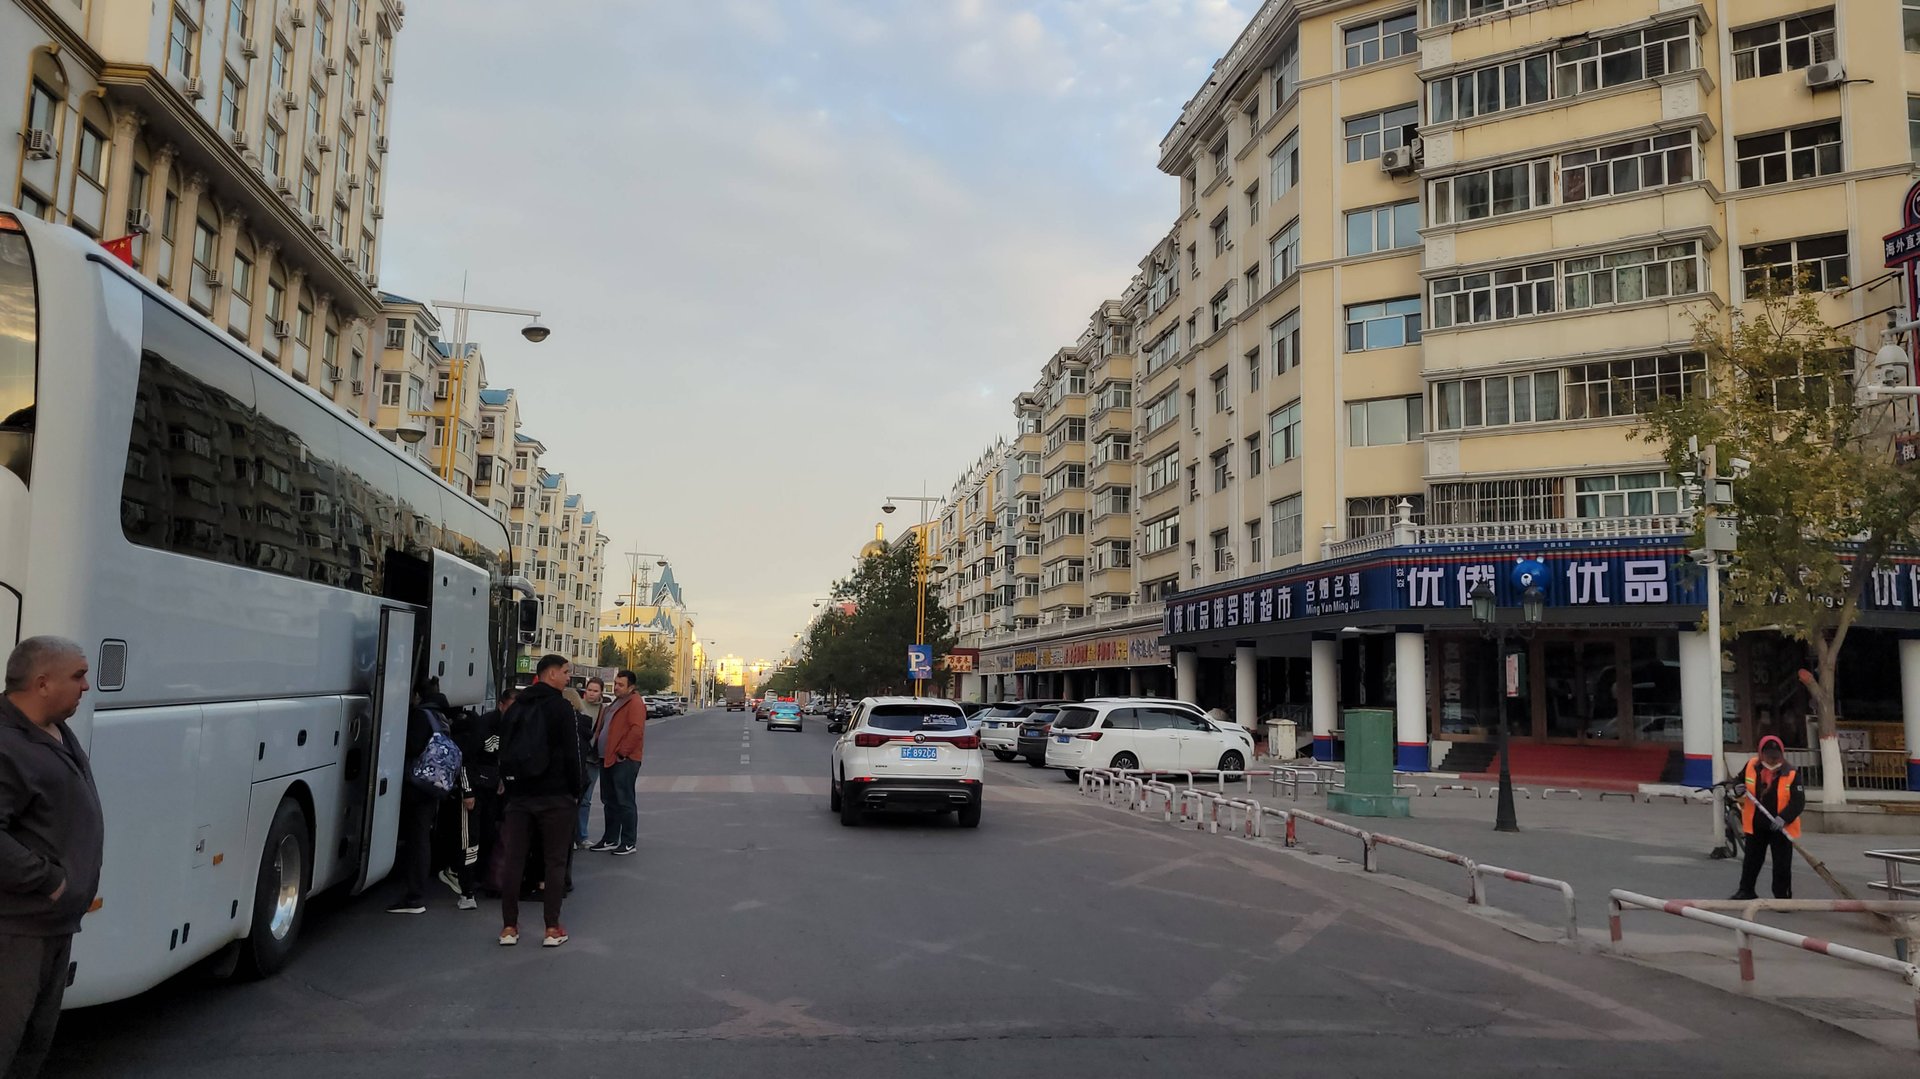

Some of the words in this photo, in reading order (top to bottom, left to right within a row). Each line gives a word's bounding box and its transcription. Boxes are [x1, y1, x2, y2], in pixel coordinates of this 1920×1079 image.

[1720, 520, 1733, 528] 公安
[1306, 572, 1360, 602] 名烟名酒
[1566, 559, 1669, 604] 优品
[1305, 604, 1321, 616] Ming
[1321, 602, 1333, 614] Yan
[1333, 600, 1349, 613] Ming
[1349, 599, 1360, 610] Jiu
[909, 652, 926, 672] P
